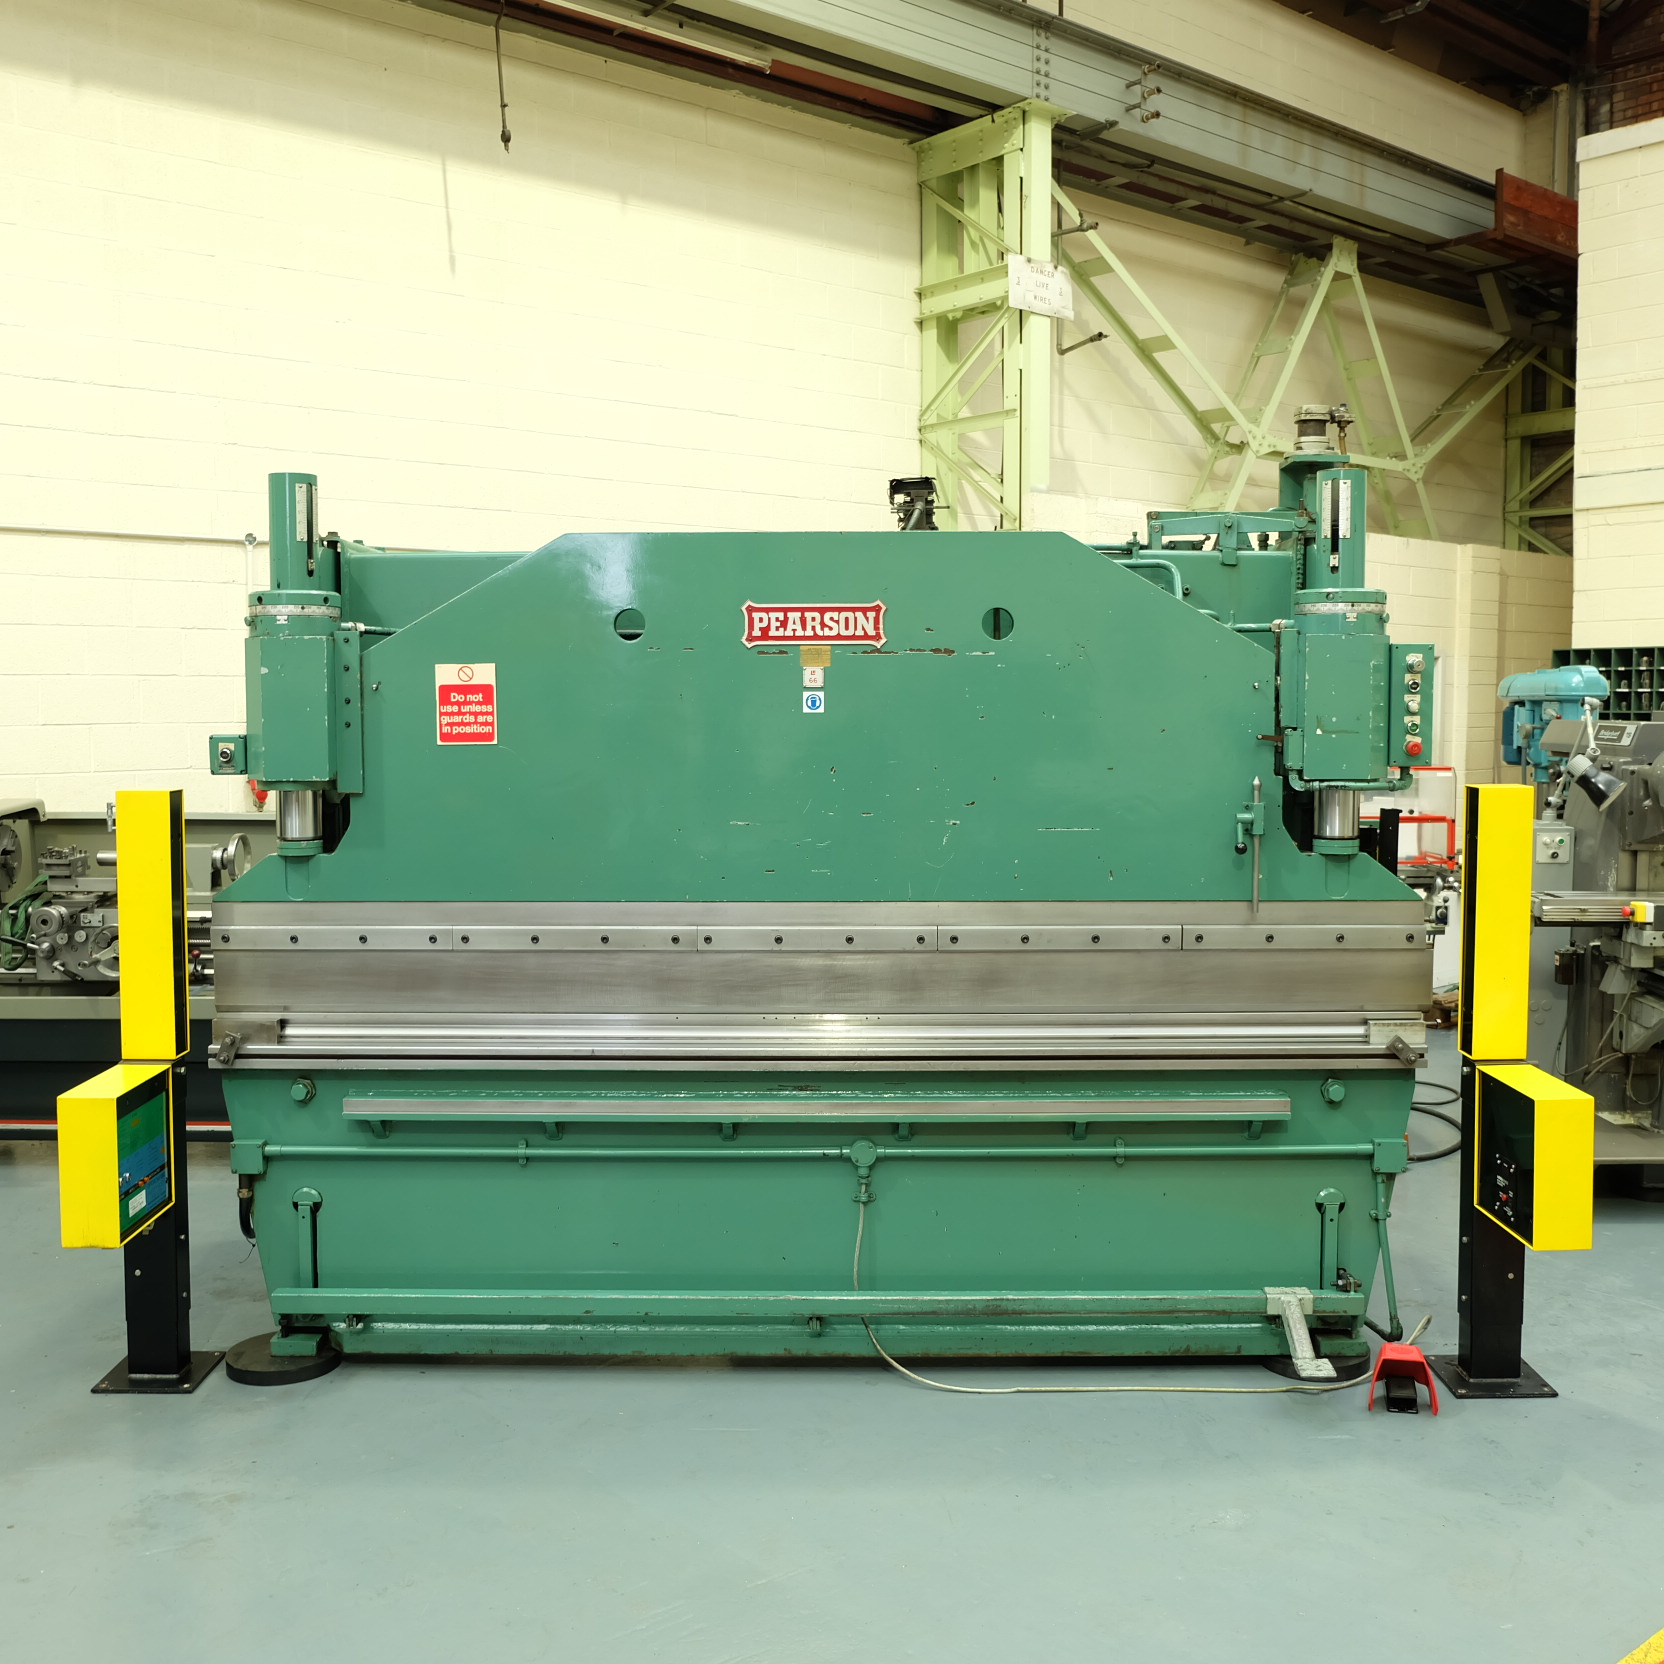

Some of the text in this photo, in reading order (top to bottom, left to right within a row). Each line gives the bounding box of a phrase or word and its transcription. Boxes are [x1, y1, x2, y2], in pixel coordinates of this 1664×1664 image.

[1031, 266, 1055, 278] DANGER
[1036, 280, 1049, 290] LIVE
[1033, 295, 1052, 306] WIRES
[751, 611, 876, 636] PEARSON
[450, 692, 483, 702] Do not
[440, 703, 493, 712] use unless
[440, 713, 493, 724] guards are
[441, 724, 493, 735] in position
